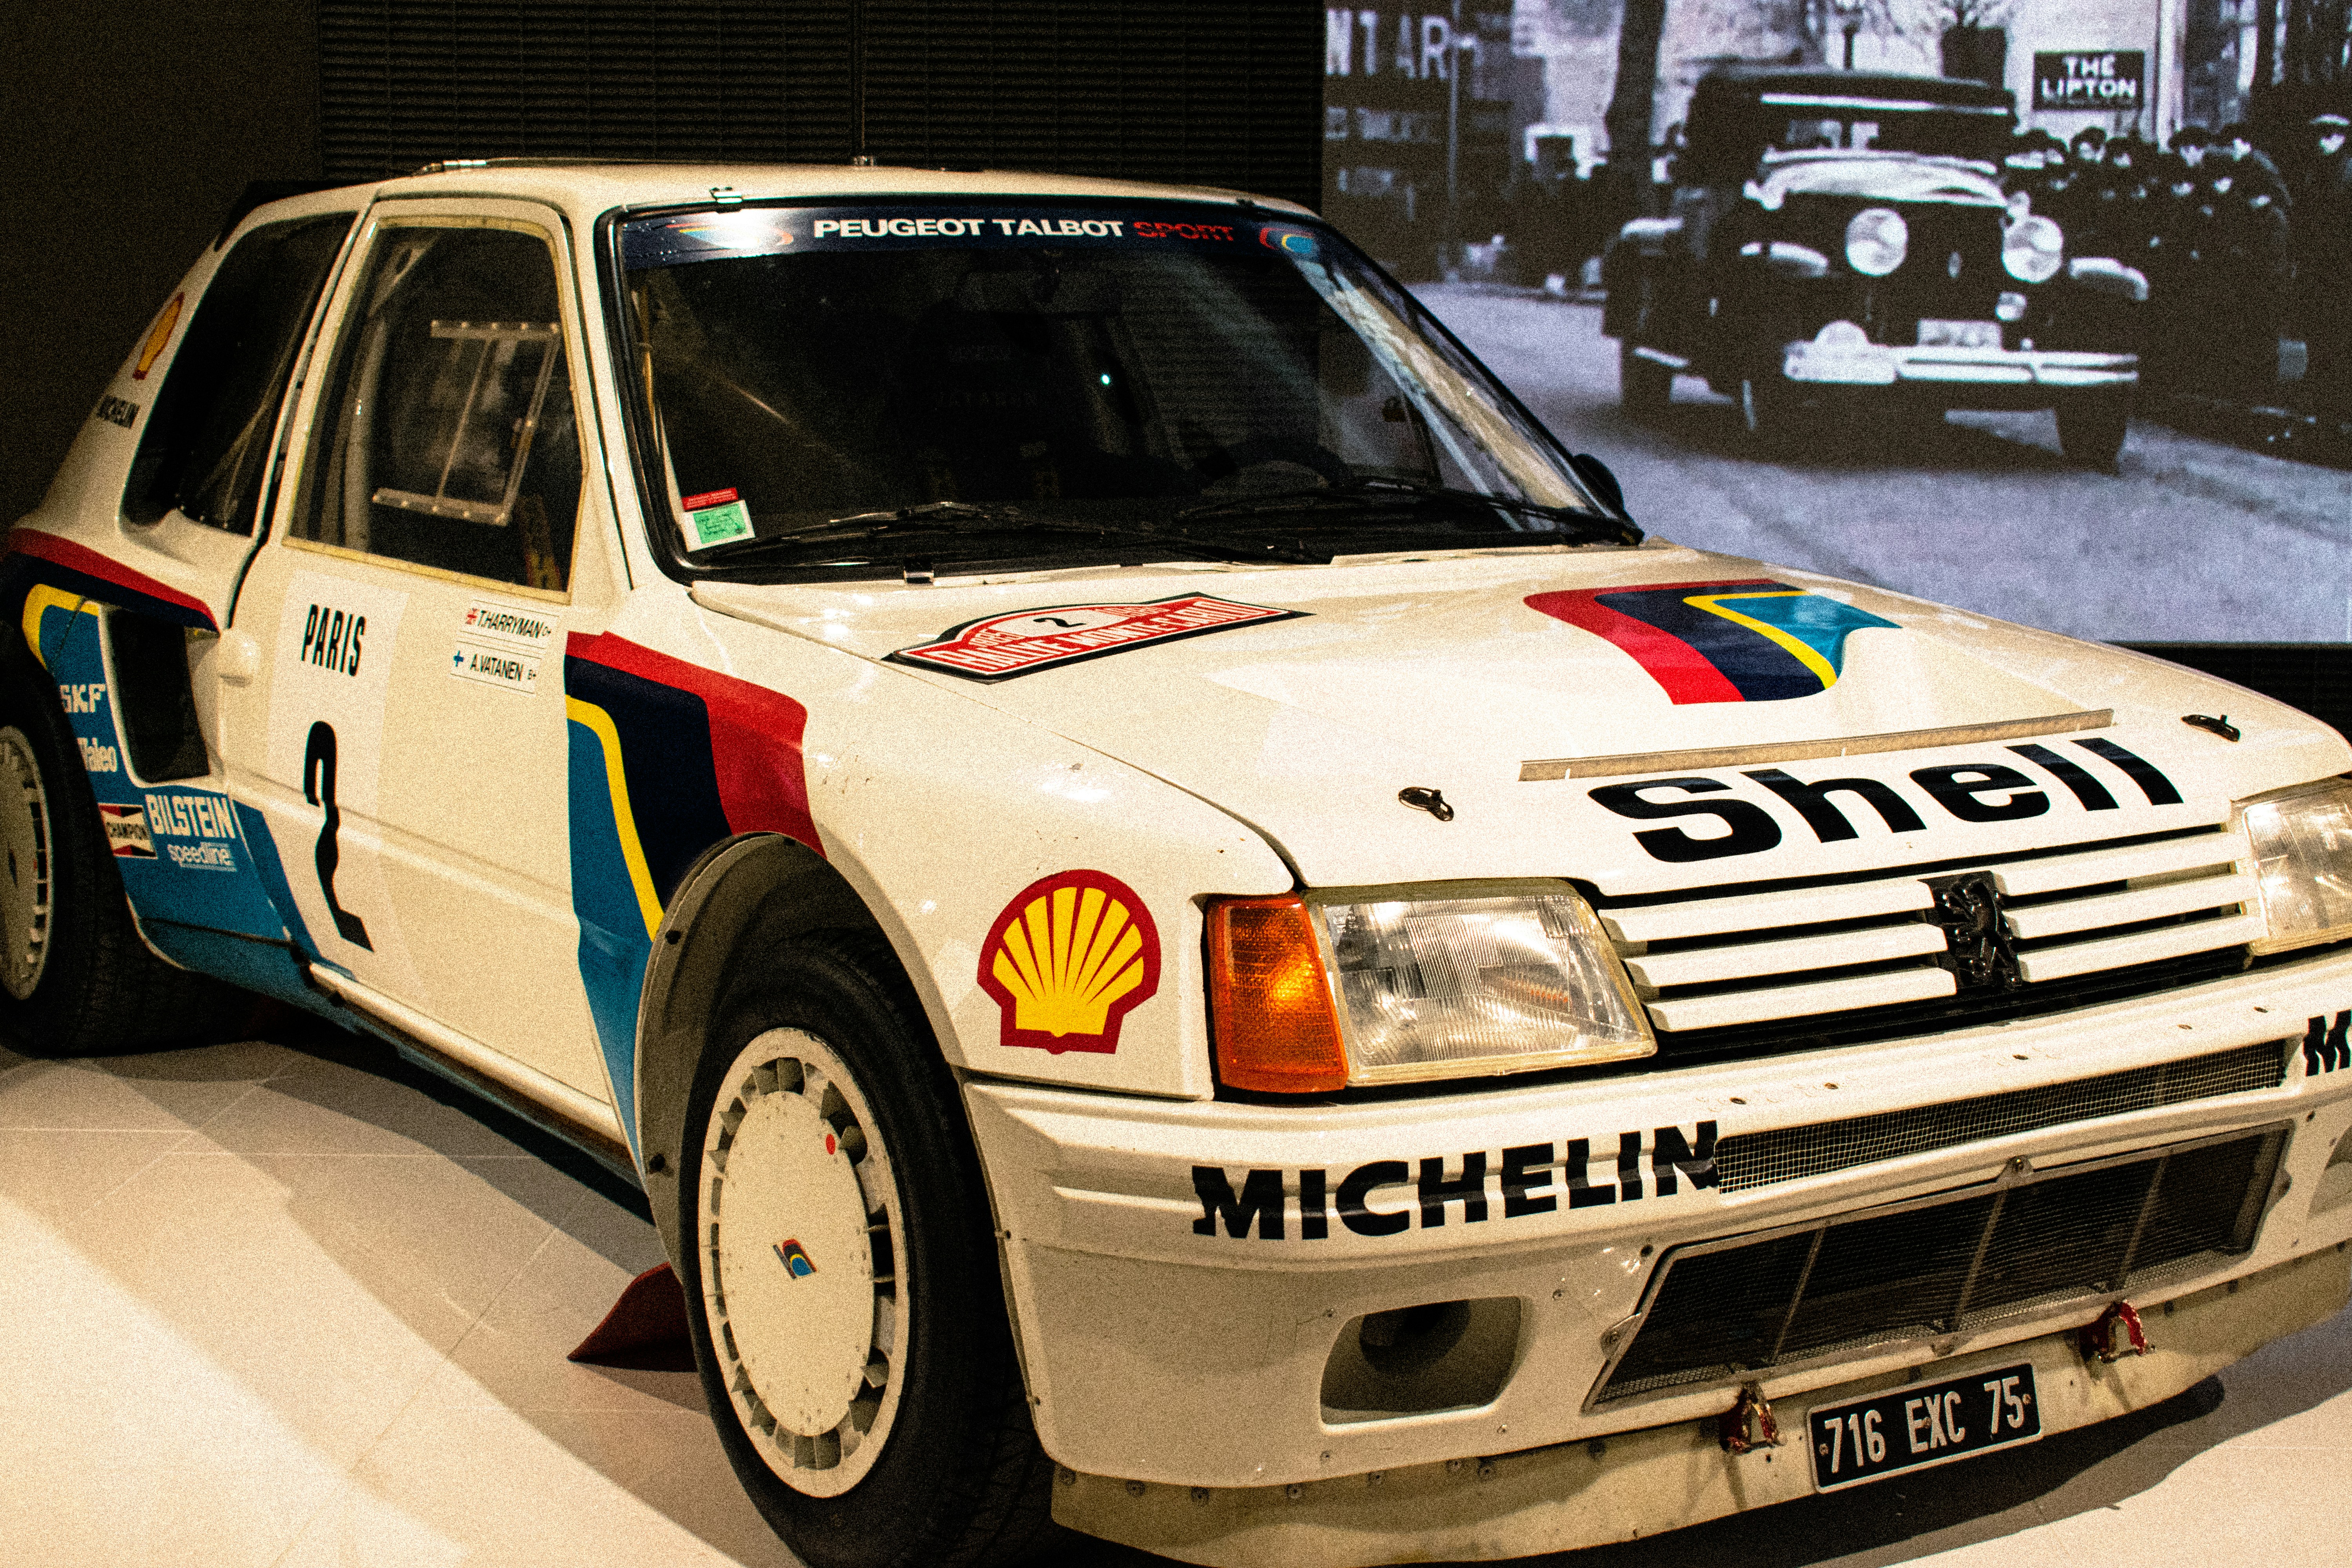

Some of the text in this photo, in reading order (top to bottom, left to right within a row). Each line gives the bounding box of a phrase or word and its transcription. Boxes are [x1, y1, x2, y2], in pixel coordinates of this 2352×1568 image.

[2062, 54, 2116, 77] THE
[2041, 78, 2137, 99] LIPTON
[814, 218, 1235, 241] PEUGEOT TALBOT SPORT
[1033, 617, 1087, 628] 2
[301, 604, 366, 677] PARIS
[923, 639, 1081, 671] RALLYE
[469, 653, 524, 681] A.VATANEN
[60, 683, 106, 713] SKF
[1587, 737, 2184, 863] Shell
[145, 794, 235, 838] BILSTEIN
[303, 720, 375, 953] 2
[167, 842, 236, 870] speedline
[1192, 1120, 1717, 1240] MICHELIN
[1824, 1376, 2025, 1473] 716 EXC 75
